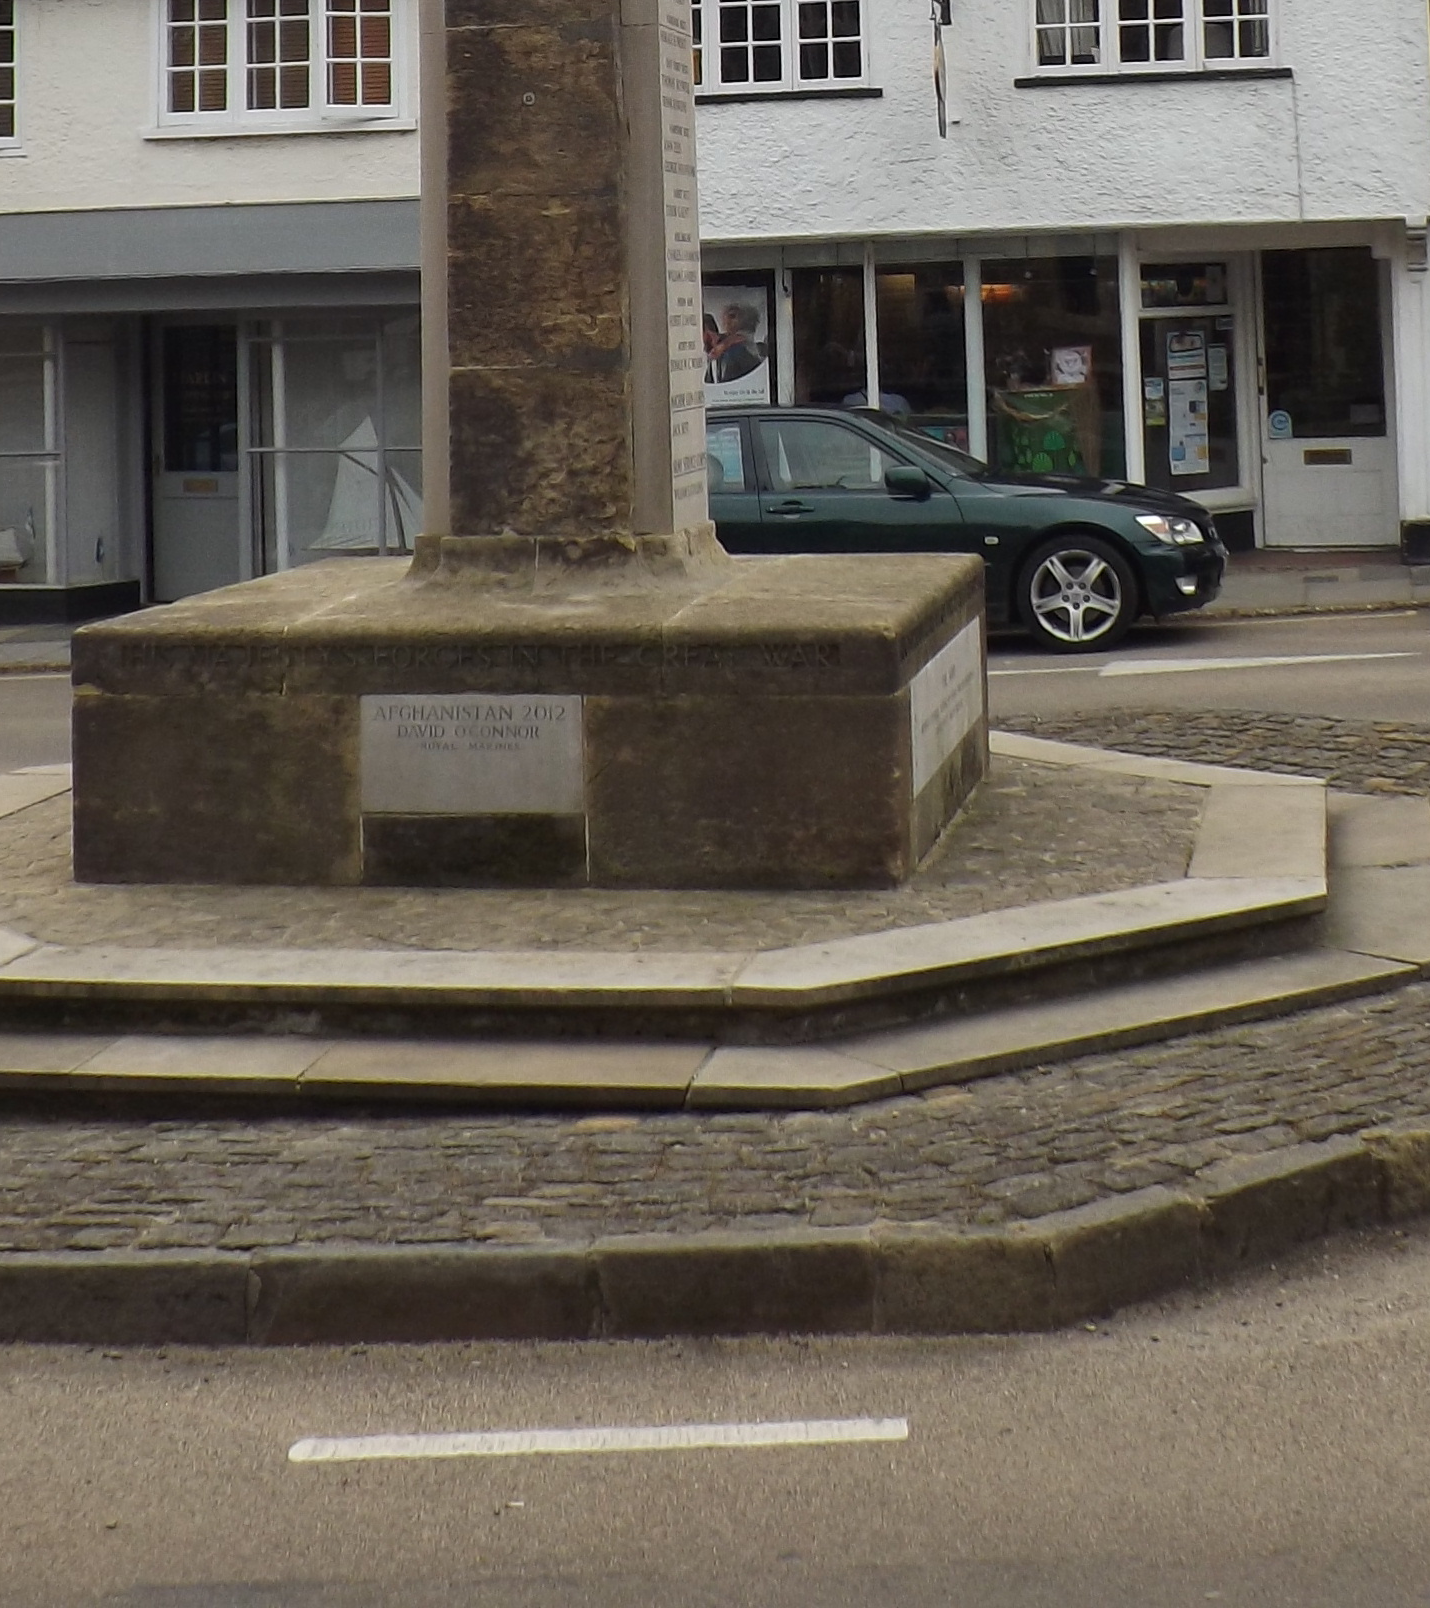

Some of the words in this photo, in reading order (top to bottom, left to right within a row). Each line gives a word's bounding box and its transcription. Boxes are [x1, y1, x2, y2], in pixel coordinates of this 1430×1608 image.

[373, 644, 492, 668] FORCES
[759, 644, 835, 668] WAR
[373, 704, 513, 722] AFGHANISTAN
[522, 705, 566, 722] 2012
[397, 724, 445, 739] DAVID
[421, 742, 458, 751] ROYAL
[468, 742, 521, 751] MARINES
